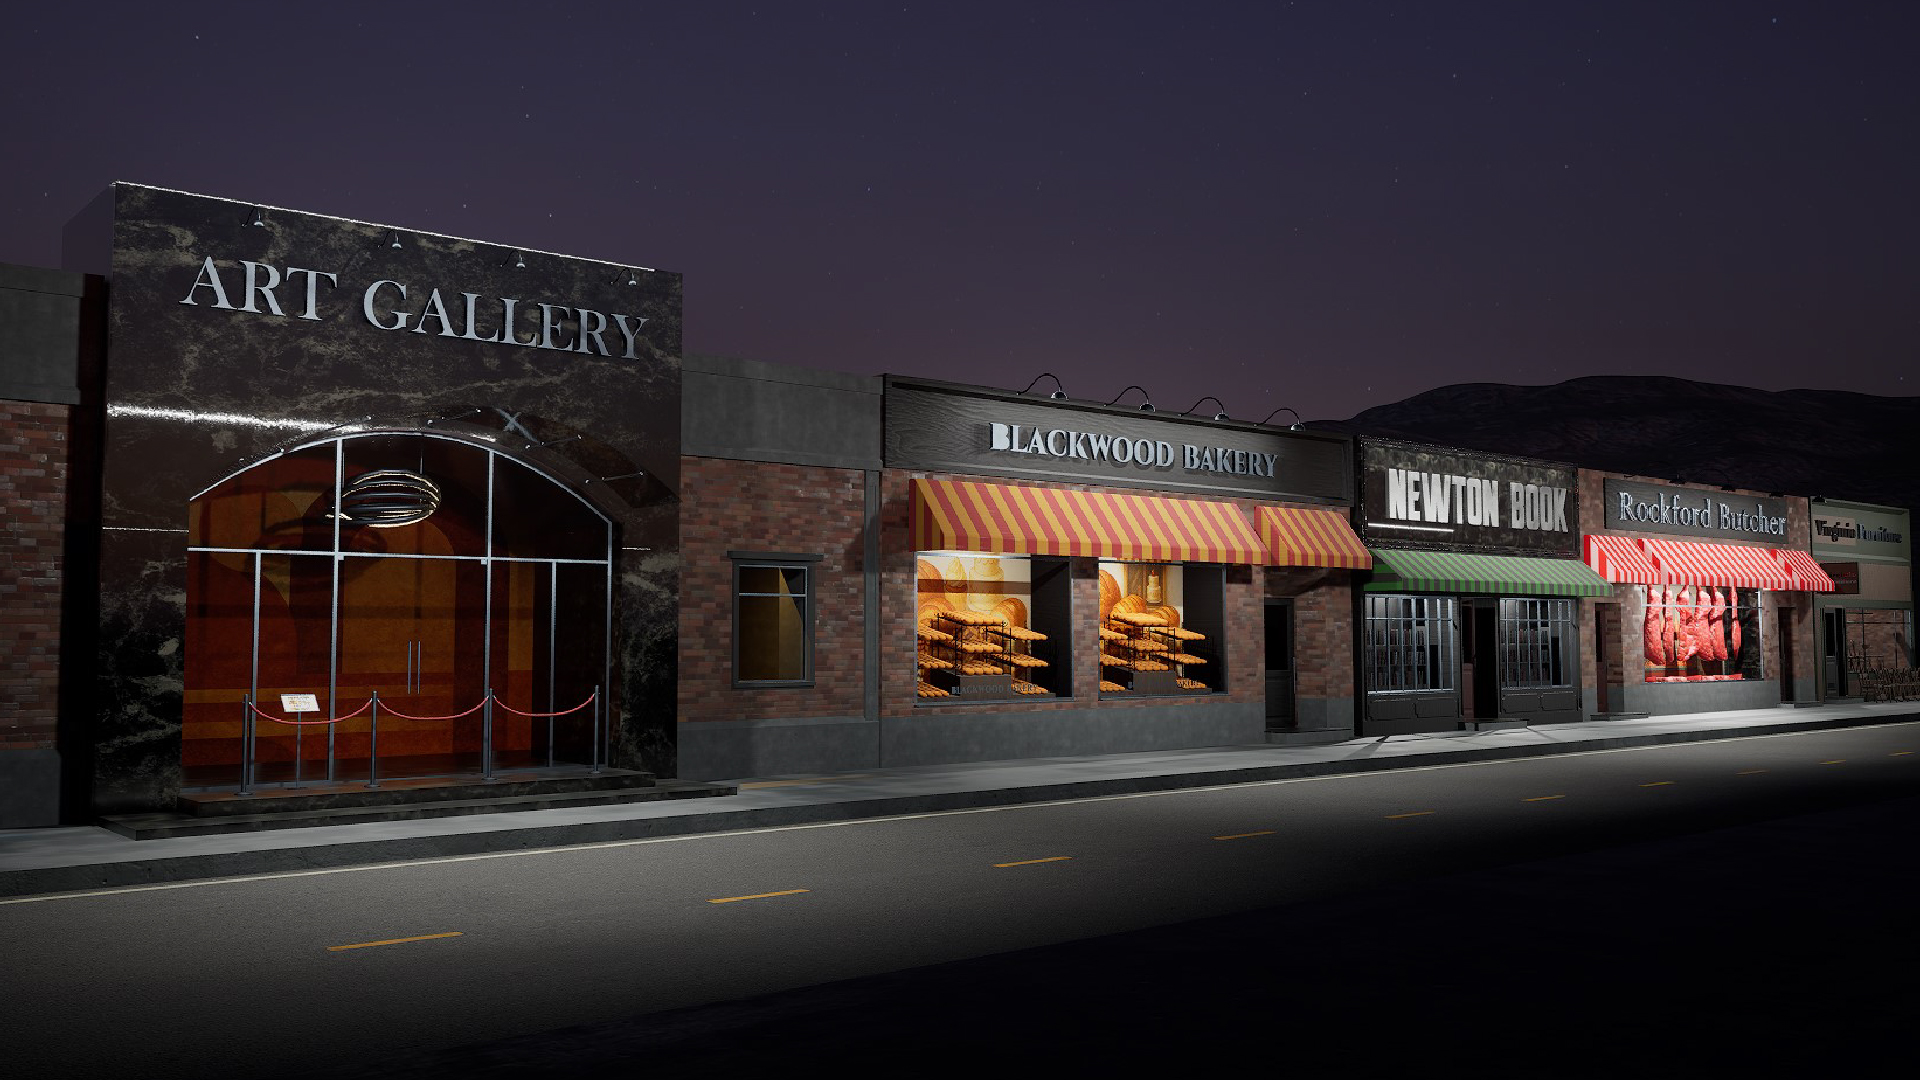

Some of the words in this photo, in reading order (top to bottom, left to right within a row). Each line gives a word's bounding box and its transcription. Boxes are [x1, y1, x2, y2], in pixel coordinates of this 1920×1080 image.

[180, 256, 337, 321] ART
[363, 279, 649, 360] GALLERY
[989, 422, 1174, 467] BLACKWOOD
[1183, 444, 1278, 477] BAKERY
[1387, 468, 1499, 527] NEWTON
[1510, 482, 1568, 532] BOOK
[1618, 491, 1711, 528] Rockford
[1718, 503, 1786, 535] Butcher
